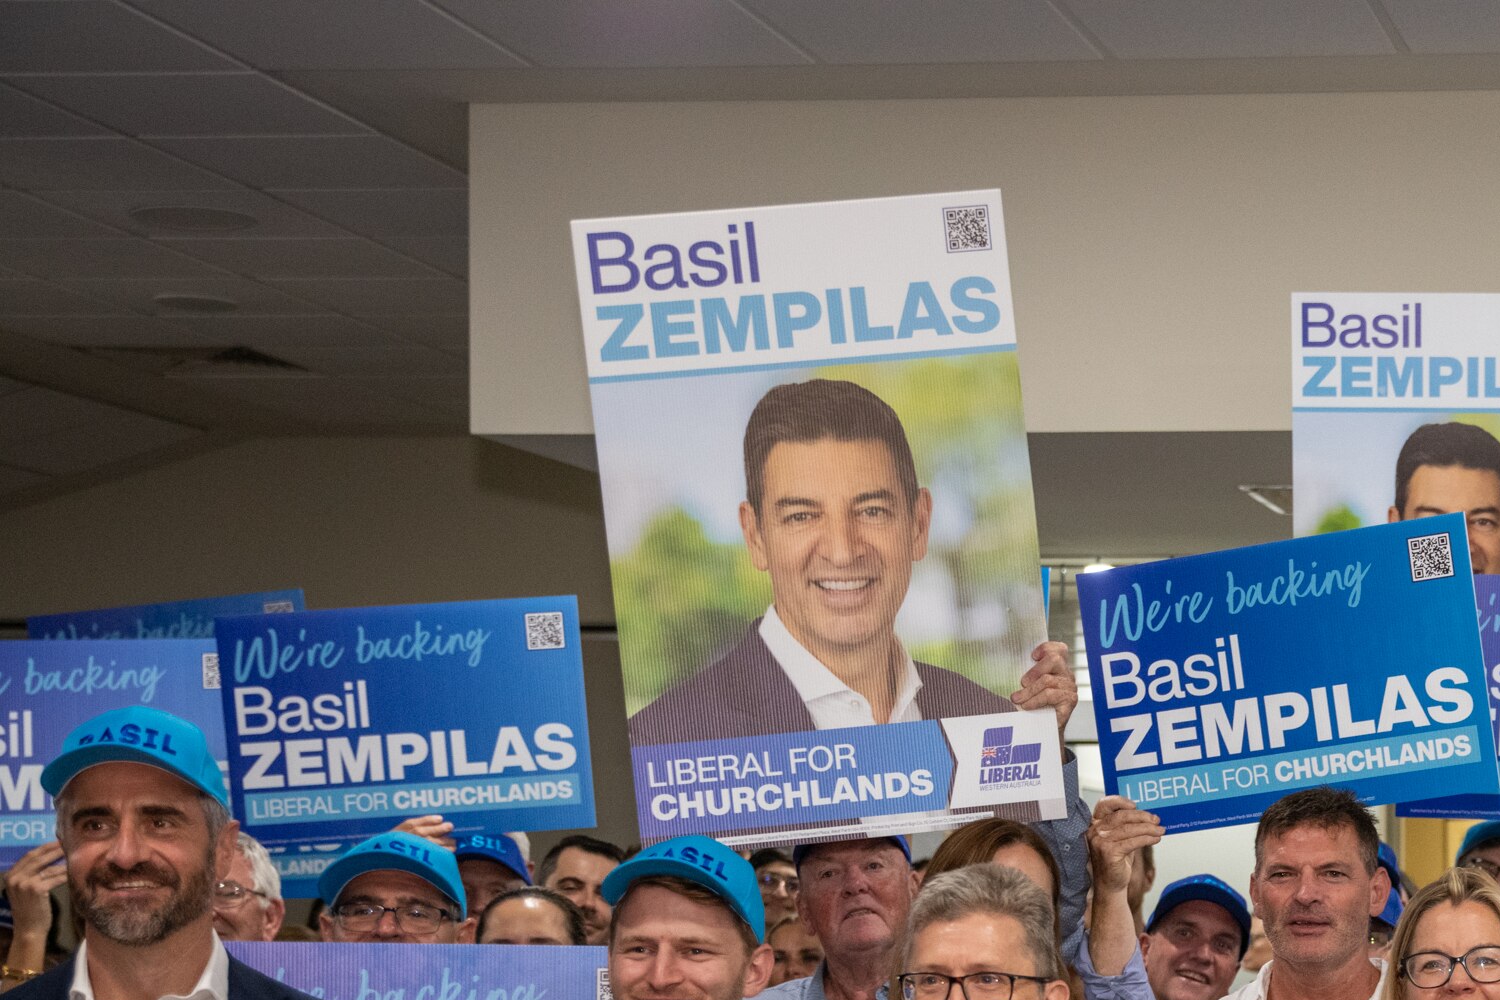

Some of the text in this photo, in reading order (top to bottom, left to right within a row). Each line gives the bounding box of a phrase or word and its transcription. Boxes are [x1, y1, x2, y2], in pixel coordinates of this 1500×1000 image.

[586, 222, 760, 294] Basil
[596, 276, 1000, 362] ZEMPILAS
[1301, 302, 1422, 348] Basil
[1100, 559, 1371, 648] We're backing
[24, 655, 167, 703] backing
[234, 621, 492, 683] We're backing
[1100, 634, 1244, 709] Basil
[234, 680, 369, 736] Basil
[1110, 666, 1474, 772] ZEMPILAS
[240, 723, 577, 790] ZEMPILAS
[647, 744, 856, 788] LIBERAL FOR
[979, 764, 1041, 784] LIBERAL
[1125, 735, 1472, 805] LIBERAL FOR CHURCHLANDS
[252, 781, 573, 819] LIBERAL FOR CHURCHLANDS
[651, 769, 933, 821] CHURCHLANDS
[980, 779, 1041, 791] WESTERN AUSTRALIA
[0, 820, 46, 840] FOR
[648, 847, 728, 881] ASIL
